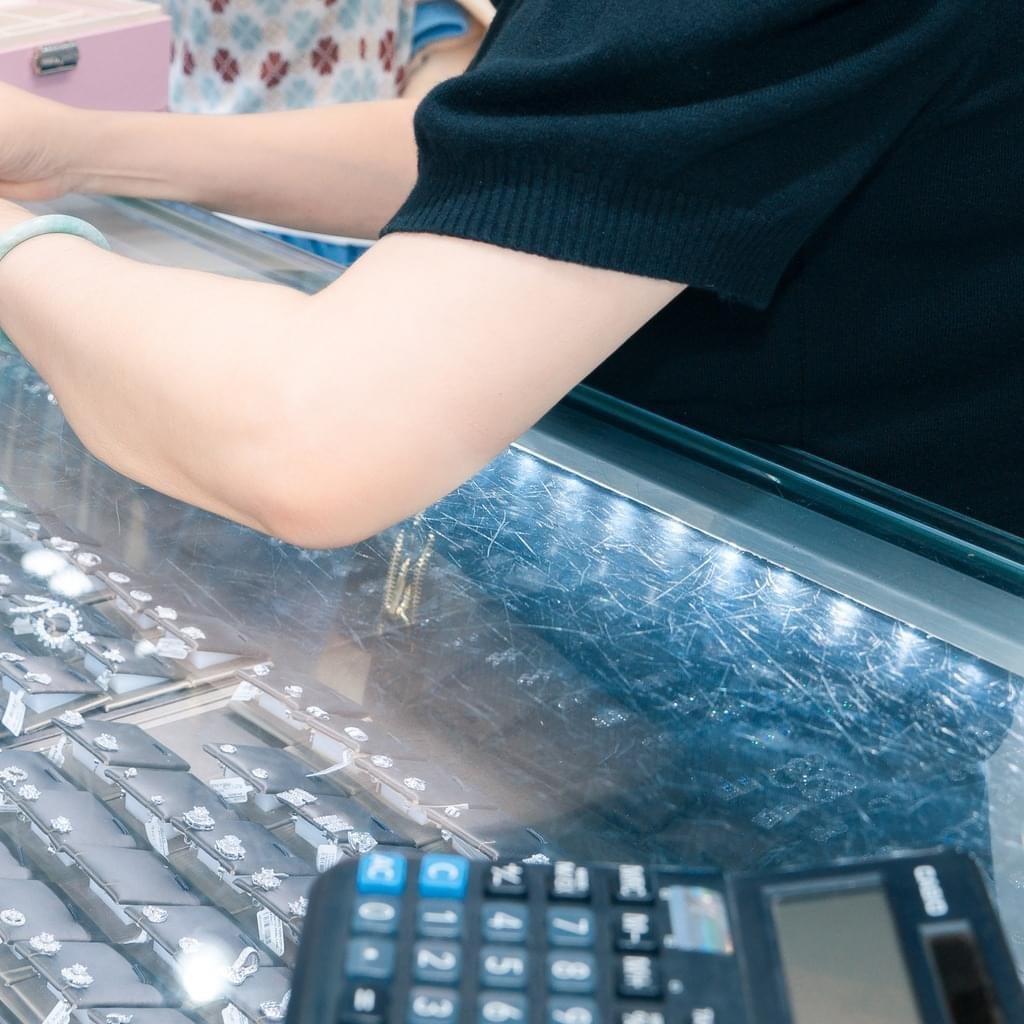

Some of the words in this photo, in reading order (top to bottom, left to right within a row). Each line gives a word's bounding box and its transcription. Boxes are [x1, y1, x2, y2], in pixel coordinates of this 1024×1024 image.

[428, 862, 459, 881] C
[423, 910, 458, 924] 1
[486, 911, 523, 930] 4
[552, 917, 590, 936] 7
[417, 949, 457, 971] 2
[484, 955, 524, 975] 5
[551, 959, 591, 980] 8
[412, 995, 453, 1019] 3
[482, 1000, 524, 1023] 6
